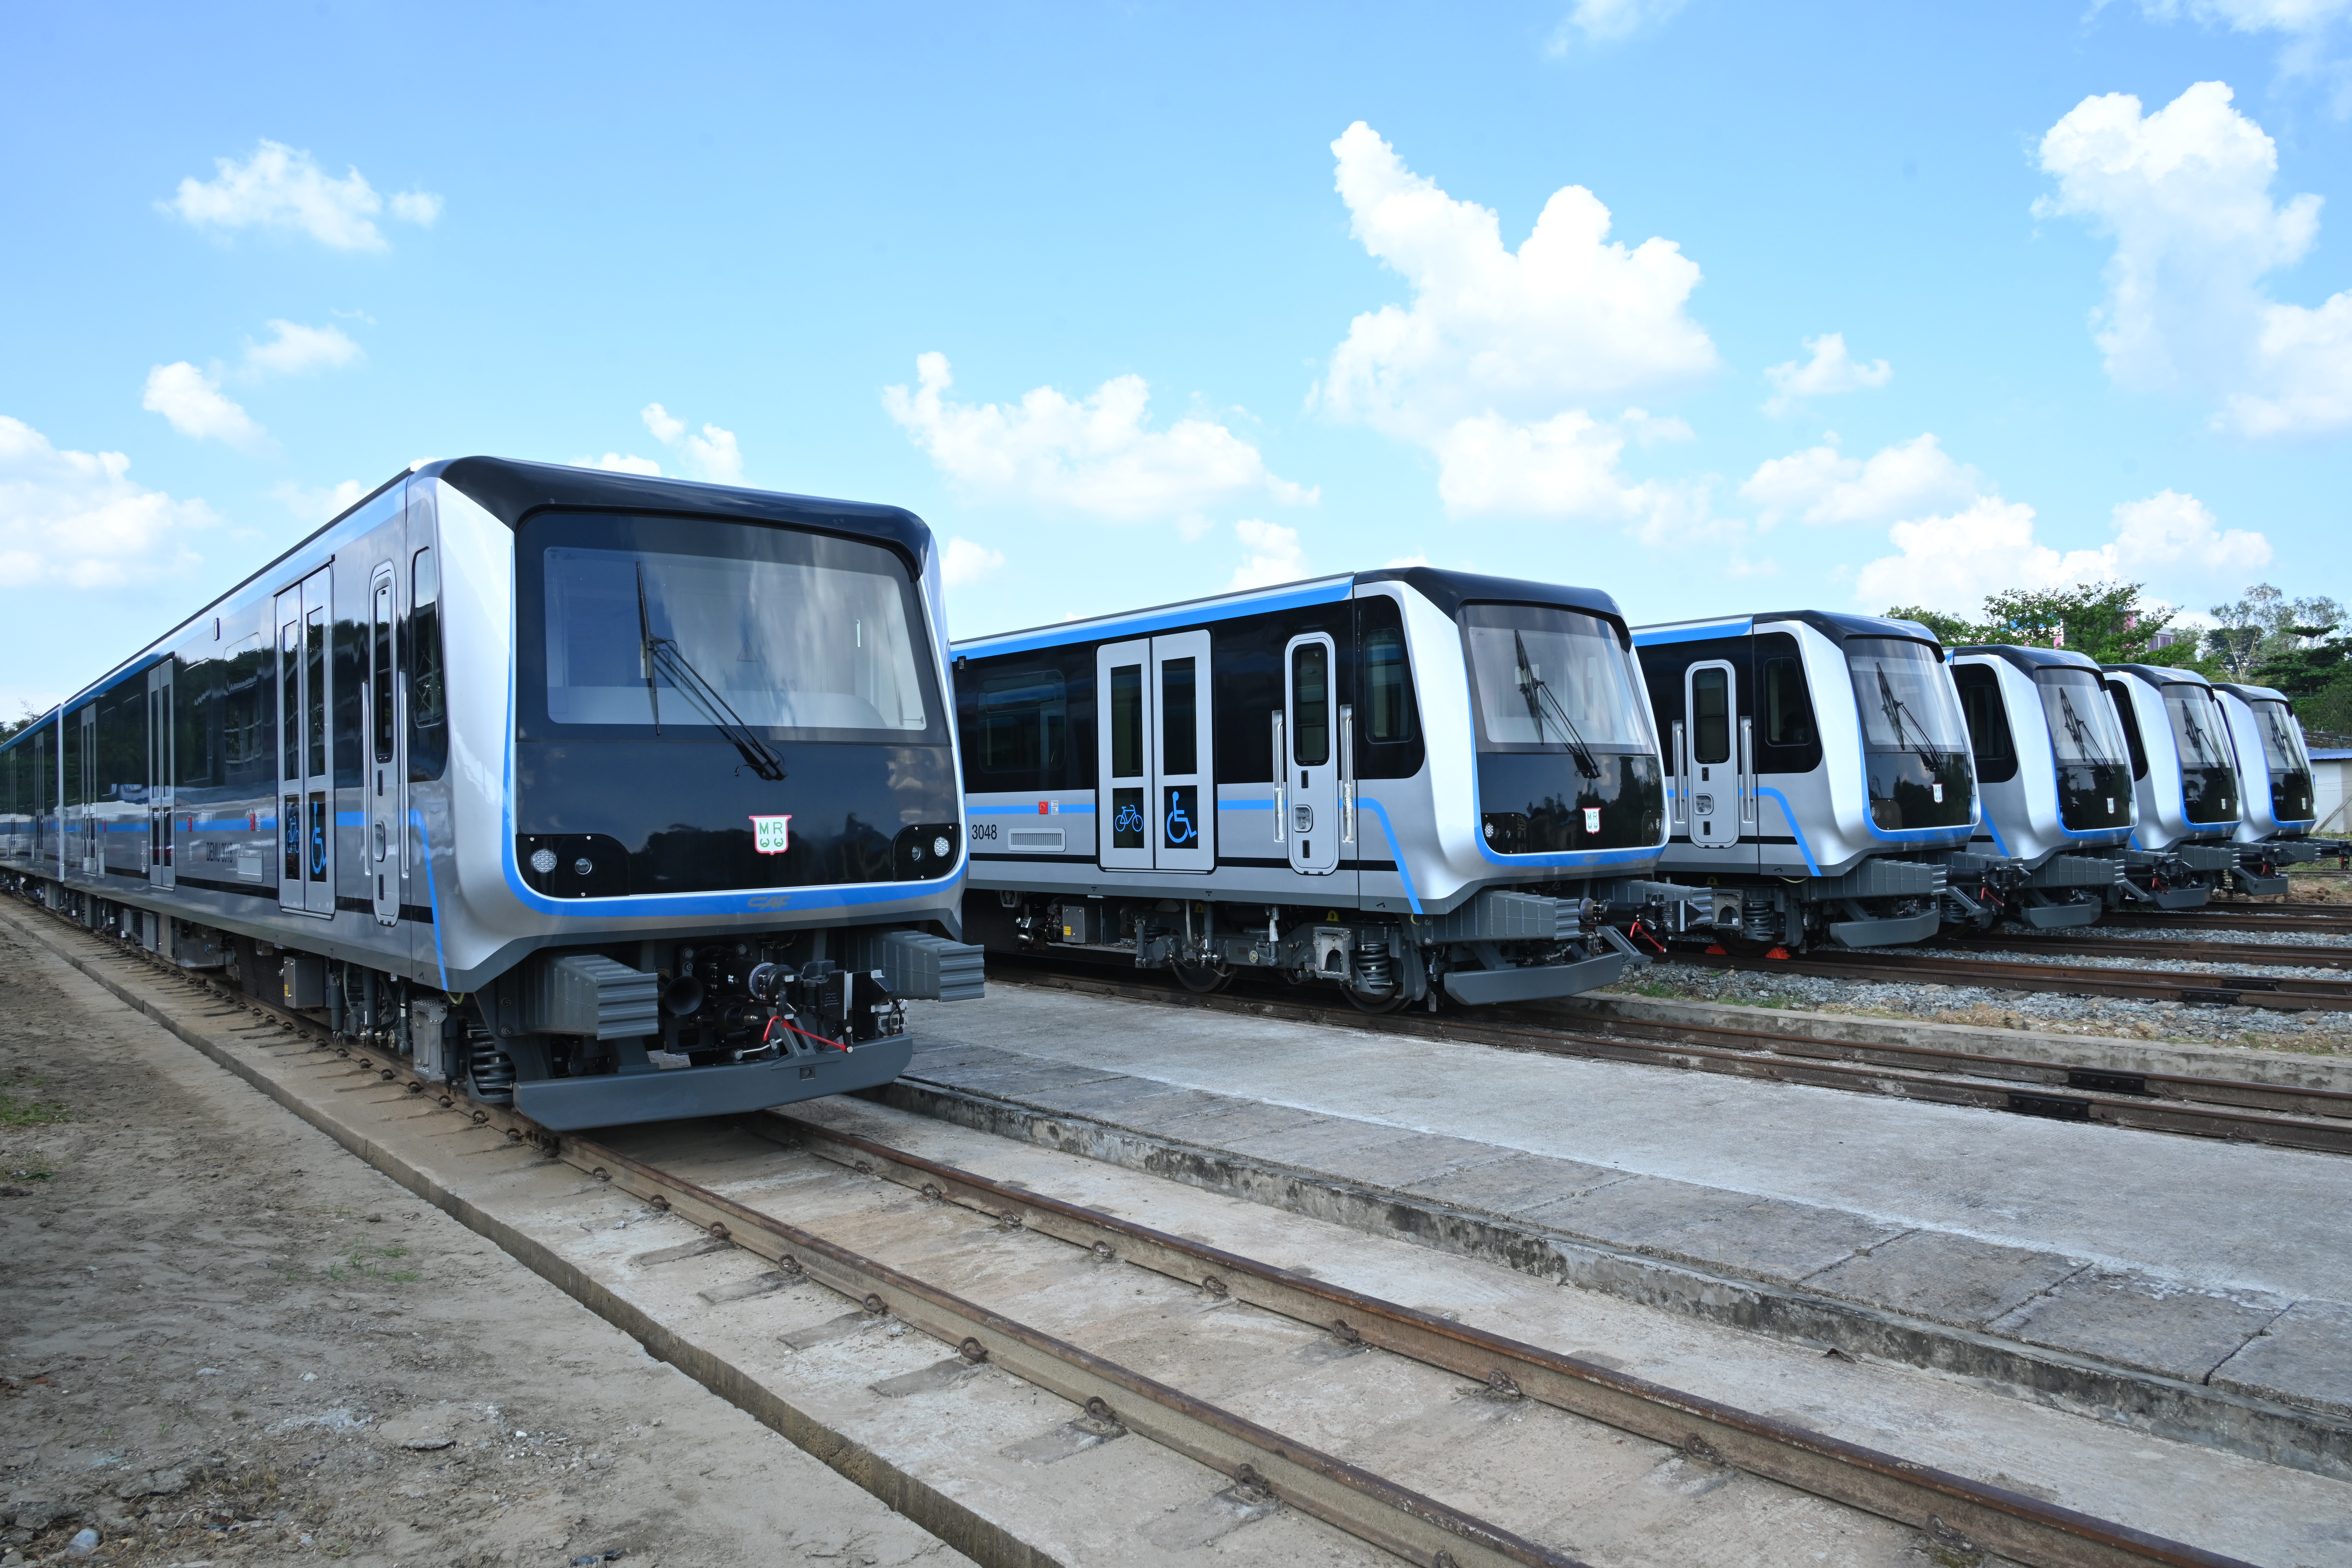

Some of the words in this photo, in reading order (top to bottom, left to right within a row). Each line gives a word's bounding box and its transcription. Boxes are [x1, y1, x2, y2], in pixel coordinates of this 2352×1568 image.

[759, 822, 783, 834] MR
[972, 824, 997, 839] 3048
[207, 842, 220, 862] DEMU
[748, 895, 792, 910] CAF
